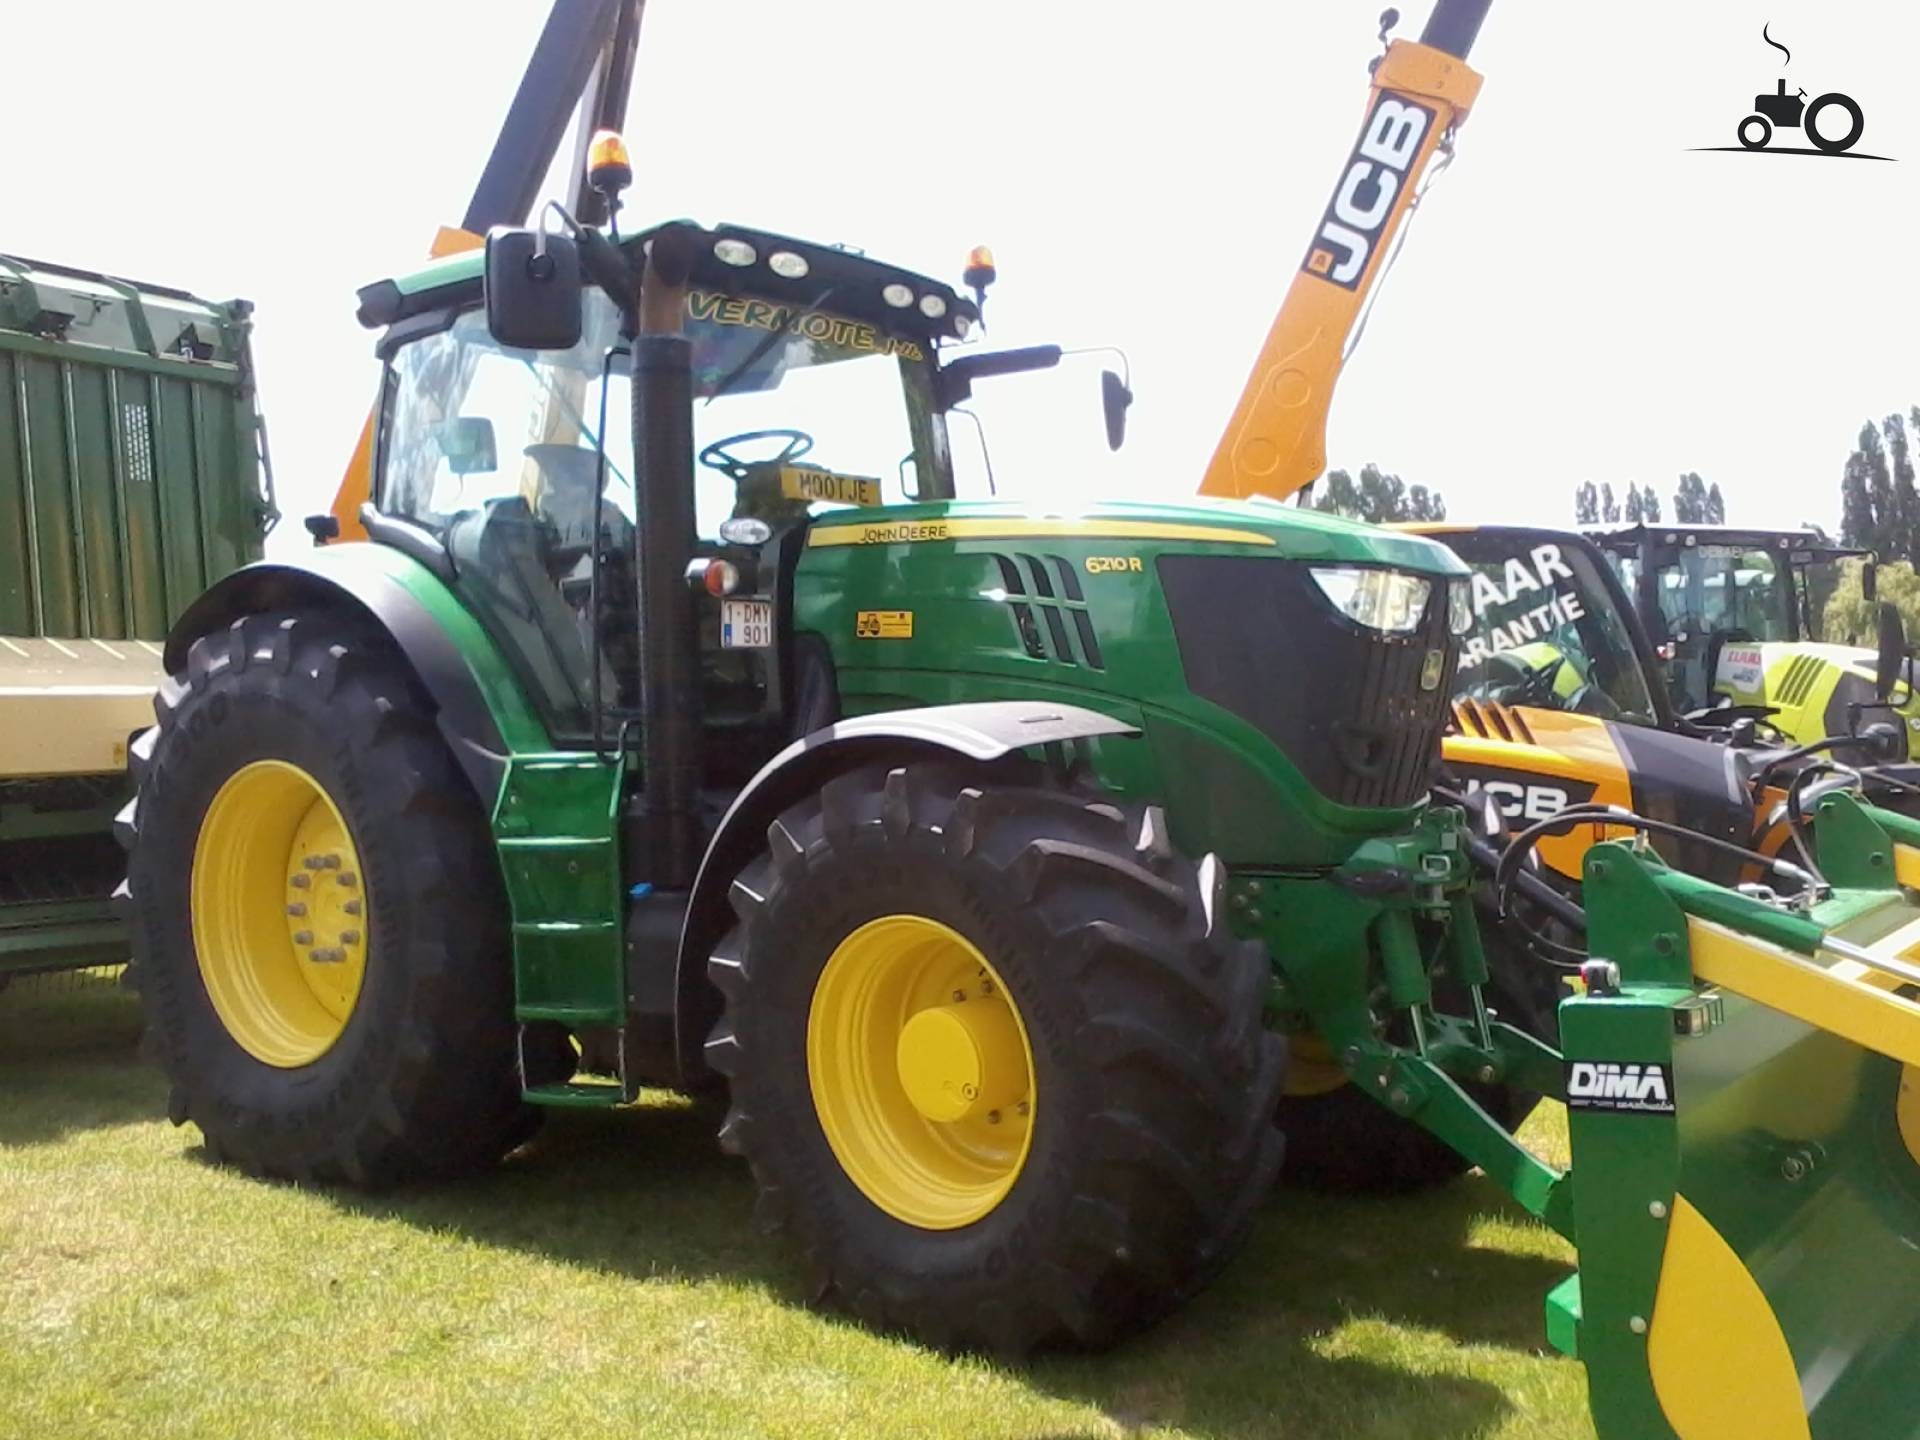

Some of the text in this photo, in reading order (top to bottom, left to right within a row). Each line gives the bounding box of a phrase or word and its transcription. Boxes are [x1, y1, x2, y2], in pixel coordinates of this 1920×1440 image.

[1321, 100, 1427, 283] JCB
[688, 291, 875, 349] VERMOTE
[860, 526, 947, 541] JOHN DEERE
[743, 625, 769, 644] 901
